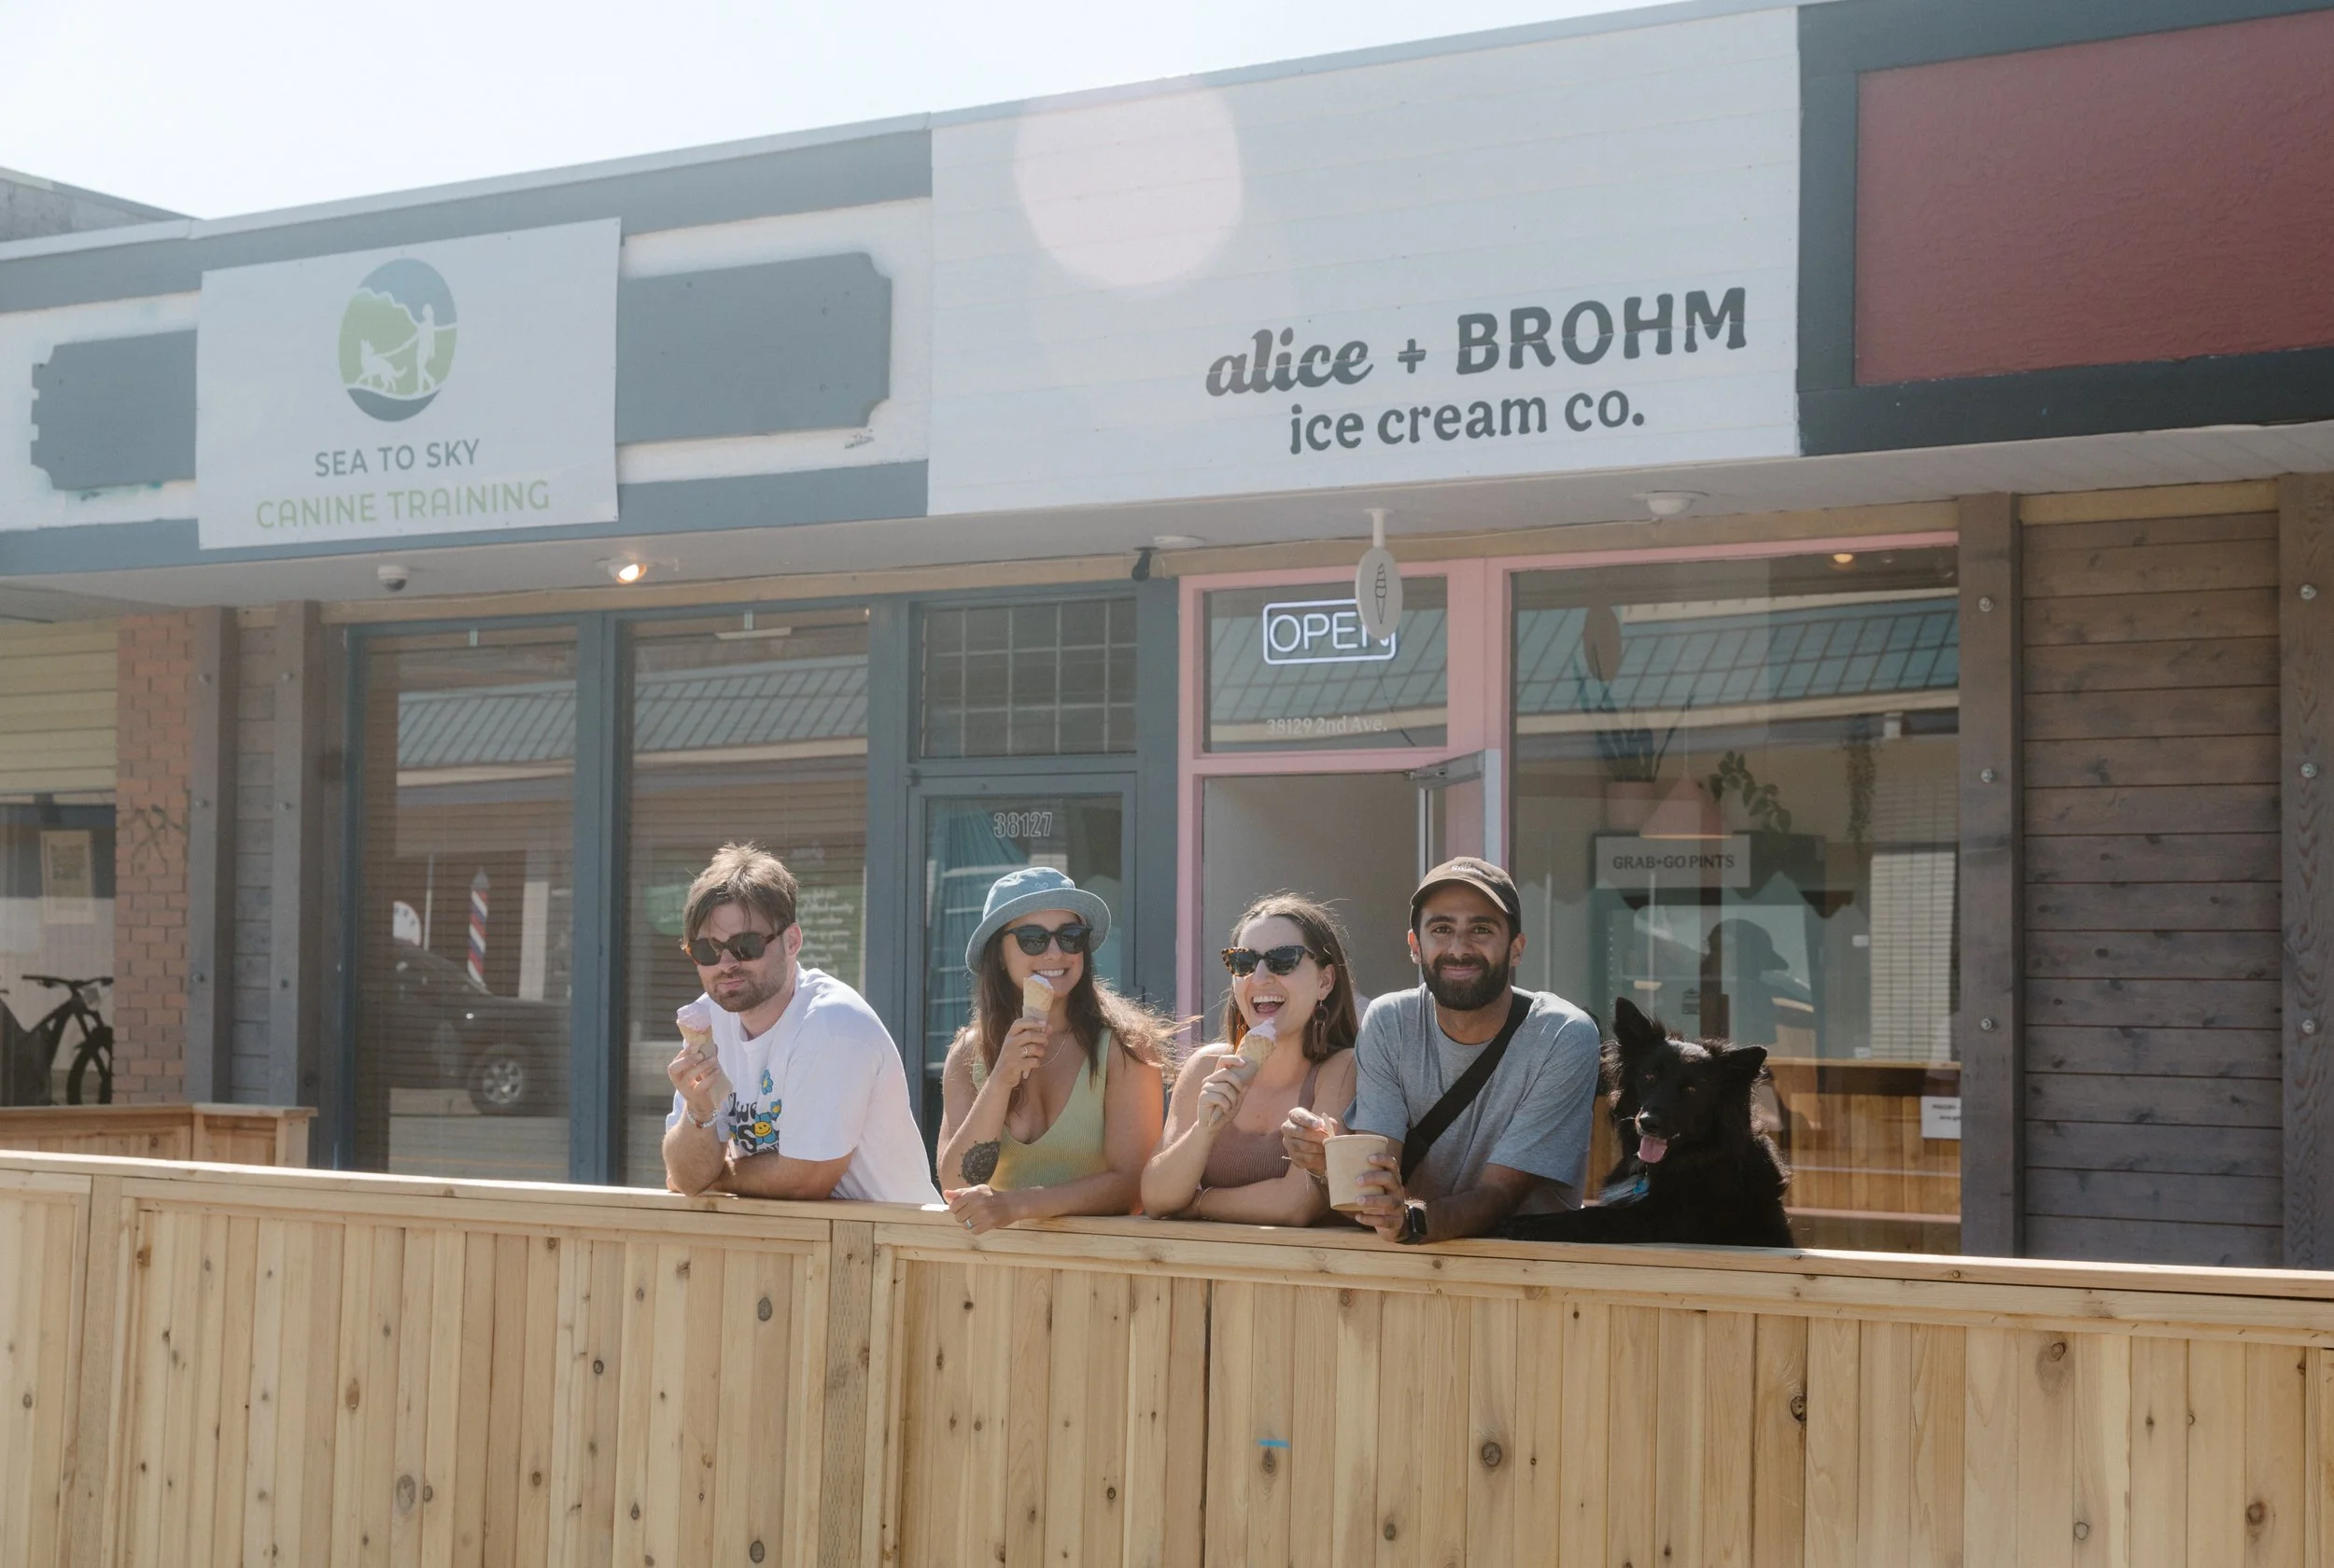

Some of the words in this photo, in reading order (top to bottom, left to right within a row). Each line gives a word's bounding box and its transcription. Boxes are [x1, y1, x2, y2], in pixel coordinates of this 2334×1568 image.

[1205, 327, 1374, 397] alice
[1398, 338, 1427, 374] +
[1455, 287, 1747, 375] BROHM
[1290, 403, 1364, 455] ice
[1377, 397, 1547, 445] cream
[1564, 390, 1645, 432] co.
[315, 448, 369, 477] SEA
[377, 445, 415, 471] TO
[426, 439, 481, 468] SKY
[256, 493, 377, 529] CANINE
[387, 480, 551, 520] TRAINING
[1266, 718, 1313, 735] 38129
[1315, 715, 1347, 734] 2nd
[1350, 715, 1388, 732] Ave.
[993, 810, 1053, 838] 38127
[1689, 853, 1735, 869] PINTS
